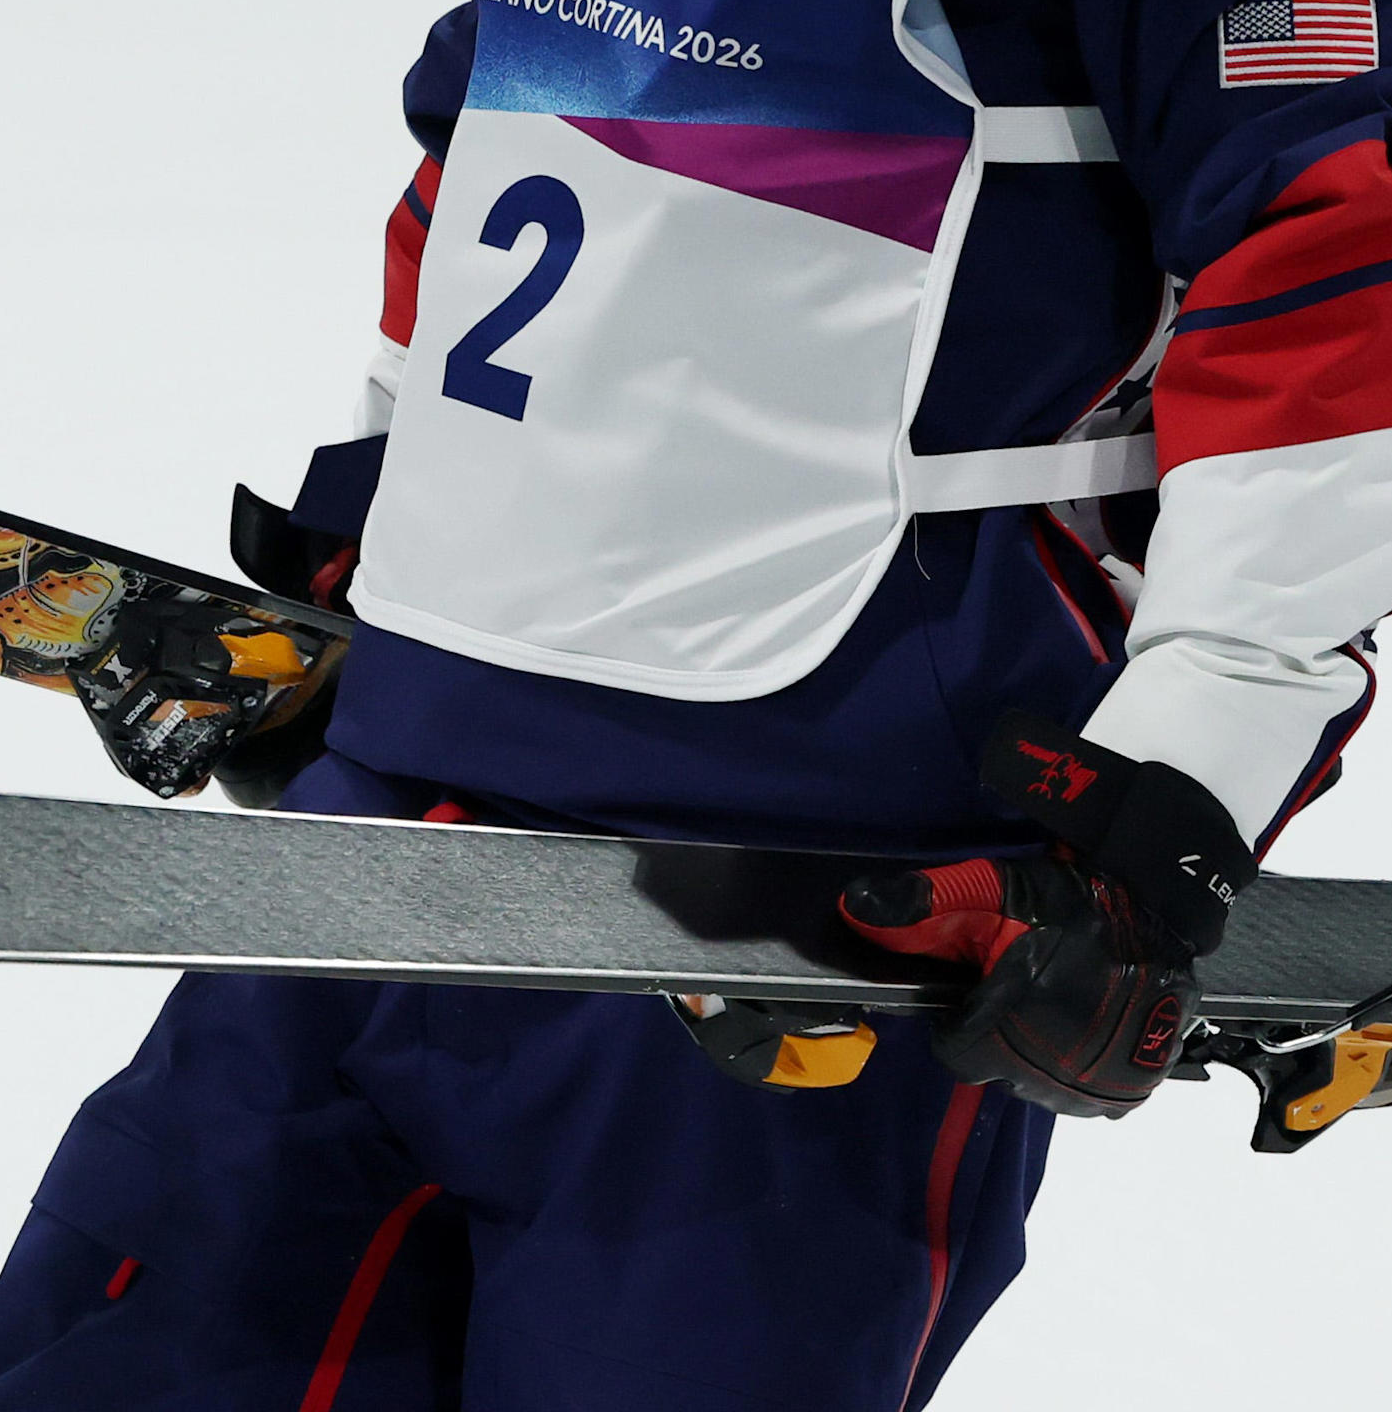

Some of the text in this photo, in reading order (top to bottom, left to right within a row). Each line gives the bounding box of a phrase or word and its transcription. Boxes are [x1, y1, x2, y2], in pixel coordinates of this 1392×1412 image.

[669, 25, 764, 71] 2026
[441, 174, 585, 422] 2
[1207, 873, 1237, 909] LEV
